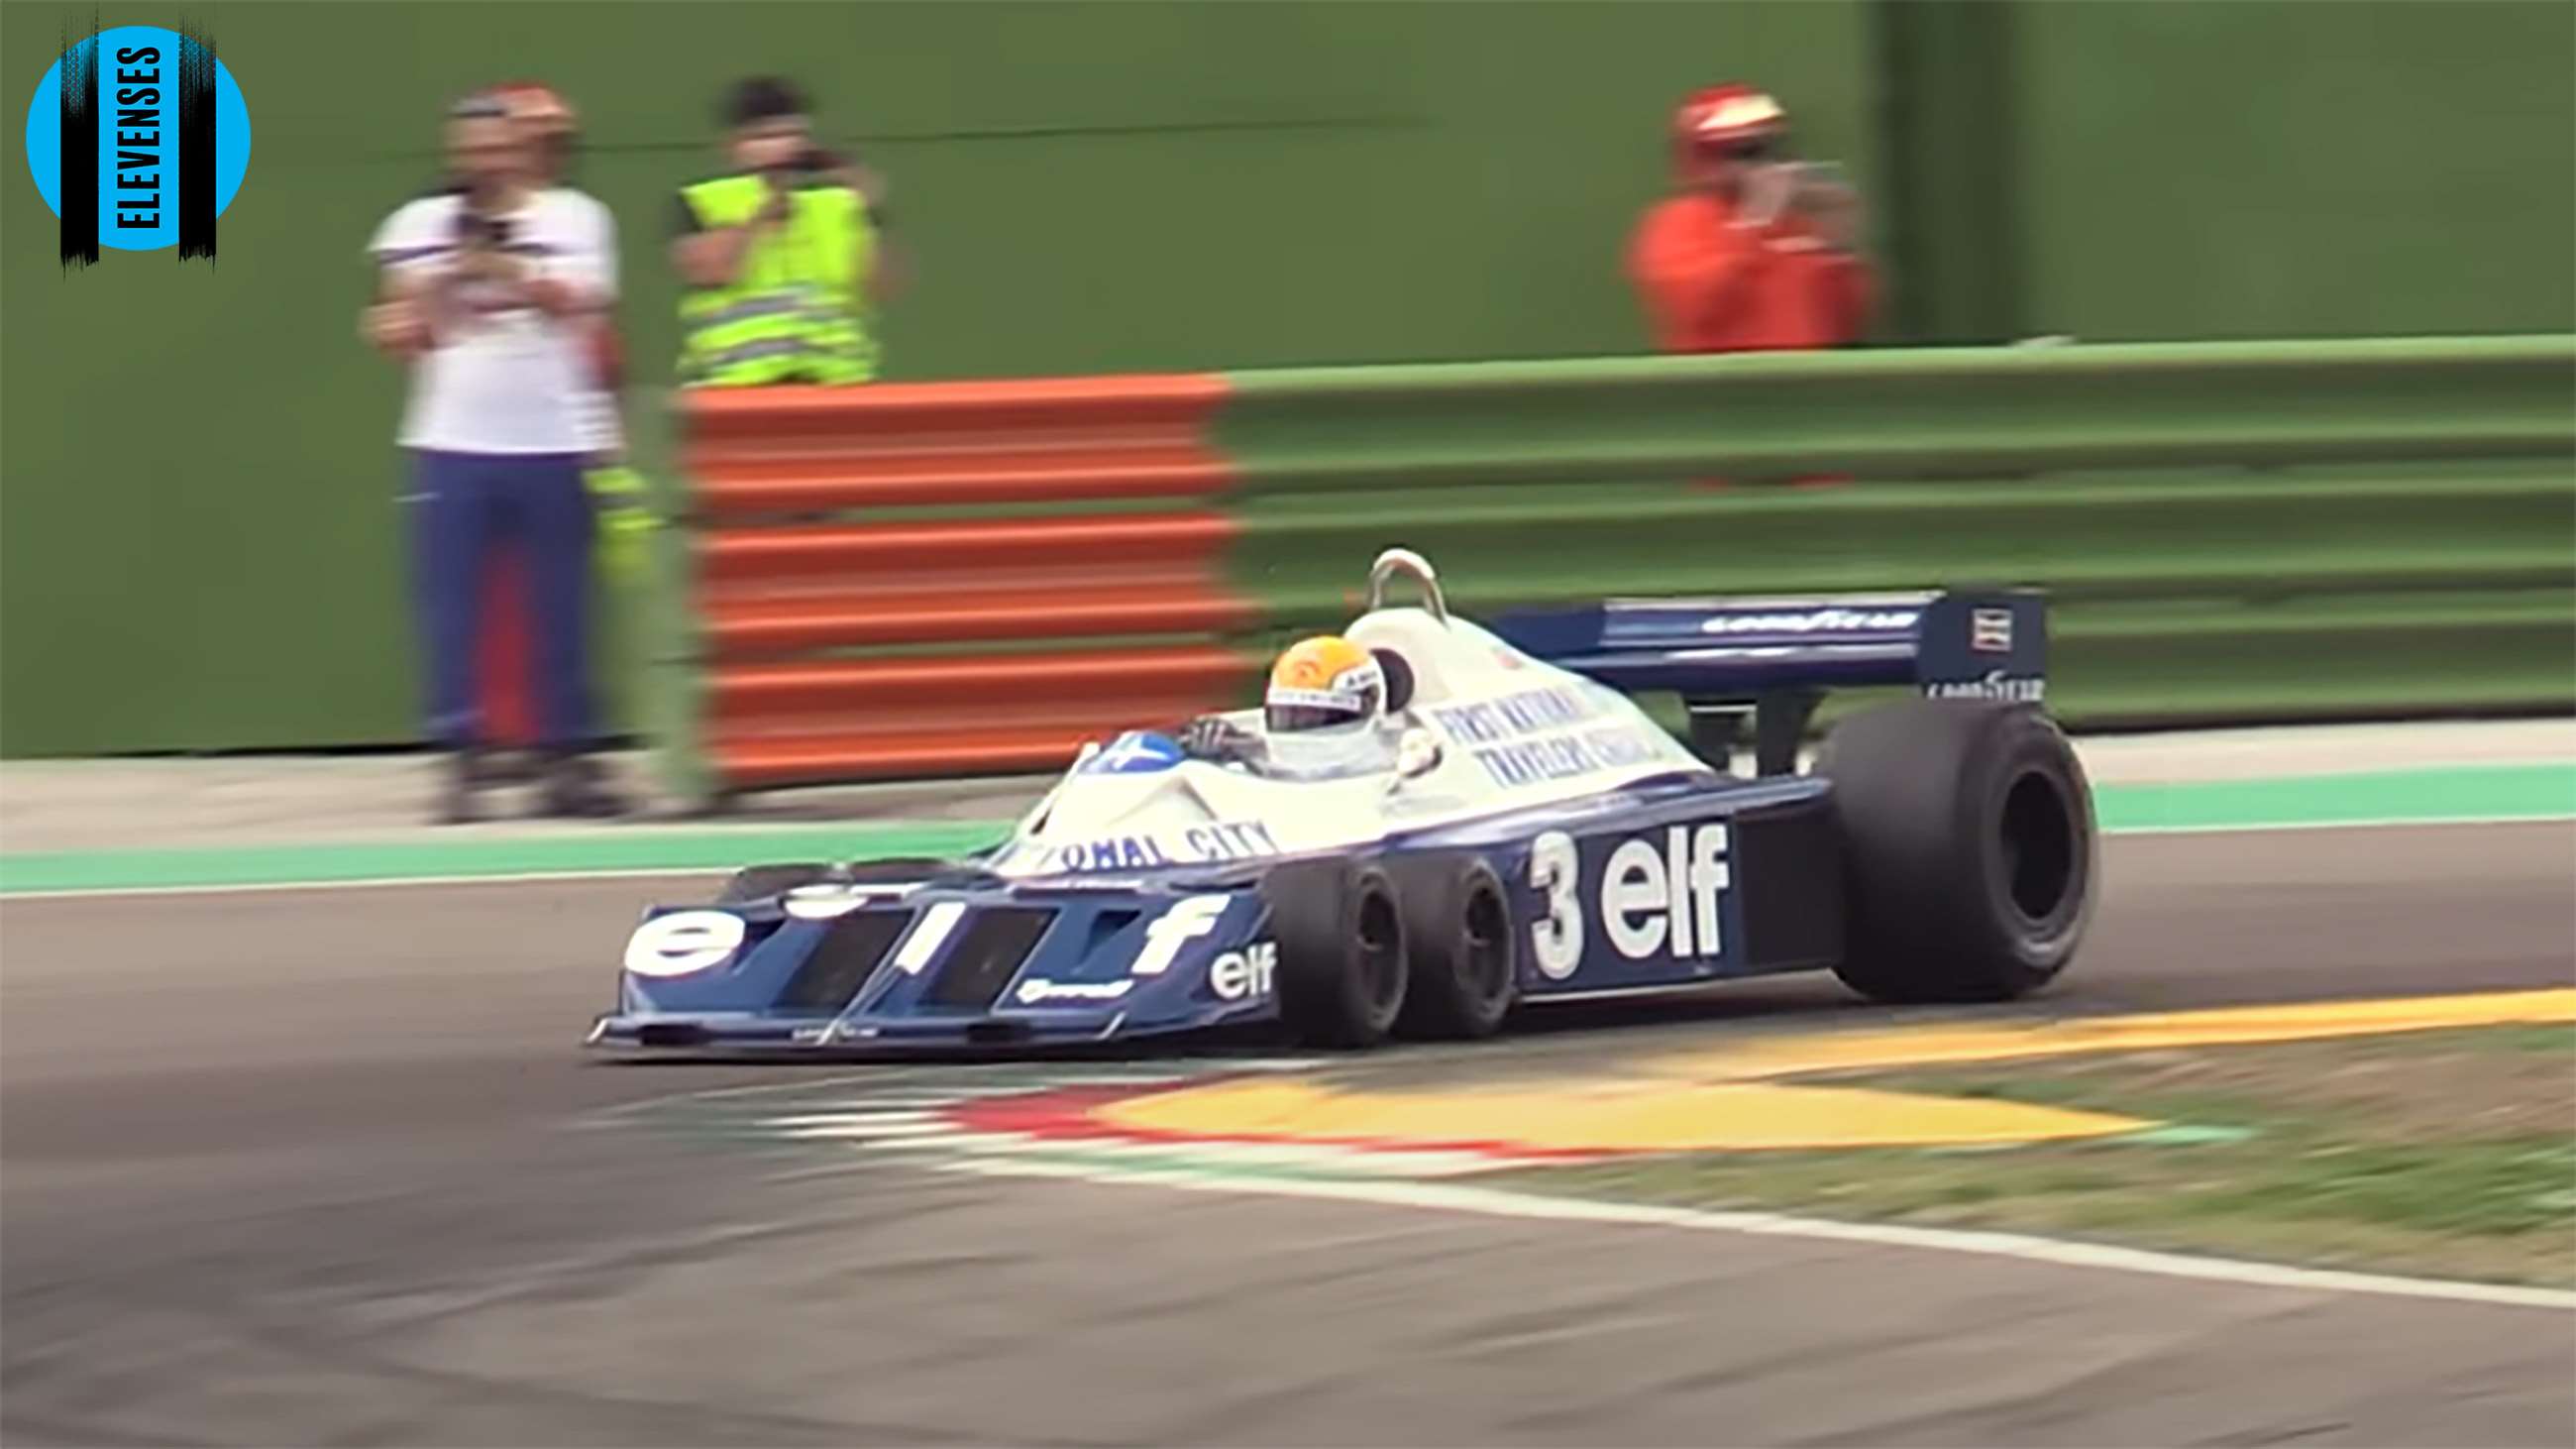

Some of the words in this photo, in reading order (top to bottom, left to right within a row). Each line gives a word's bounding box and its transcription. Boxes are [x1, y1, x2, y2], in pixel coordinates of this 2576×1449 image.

[1185, 822, 1279, 861] CITY
[1530, 830, 1584, 979] 3
[1601, 824, 1730, 958] elf
[1211, 941, 1277, 999] elf
